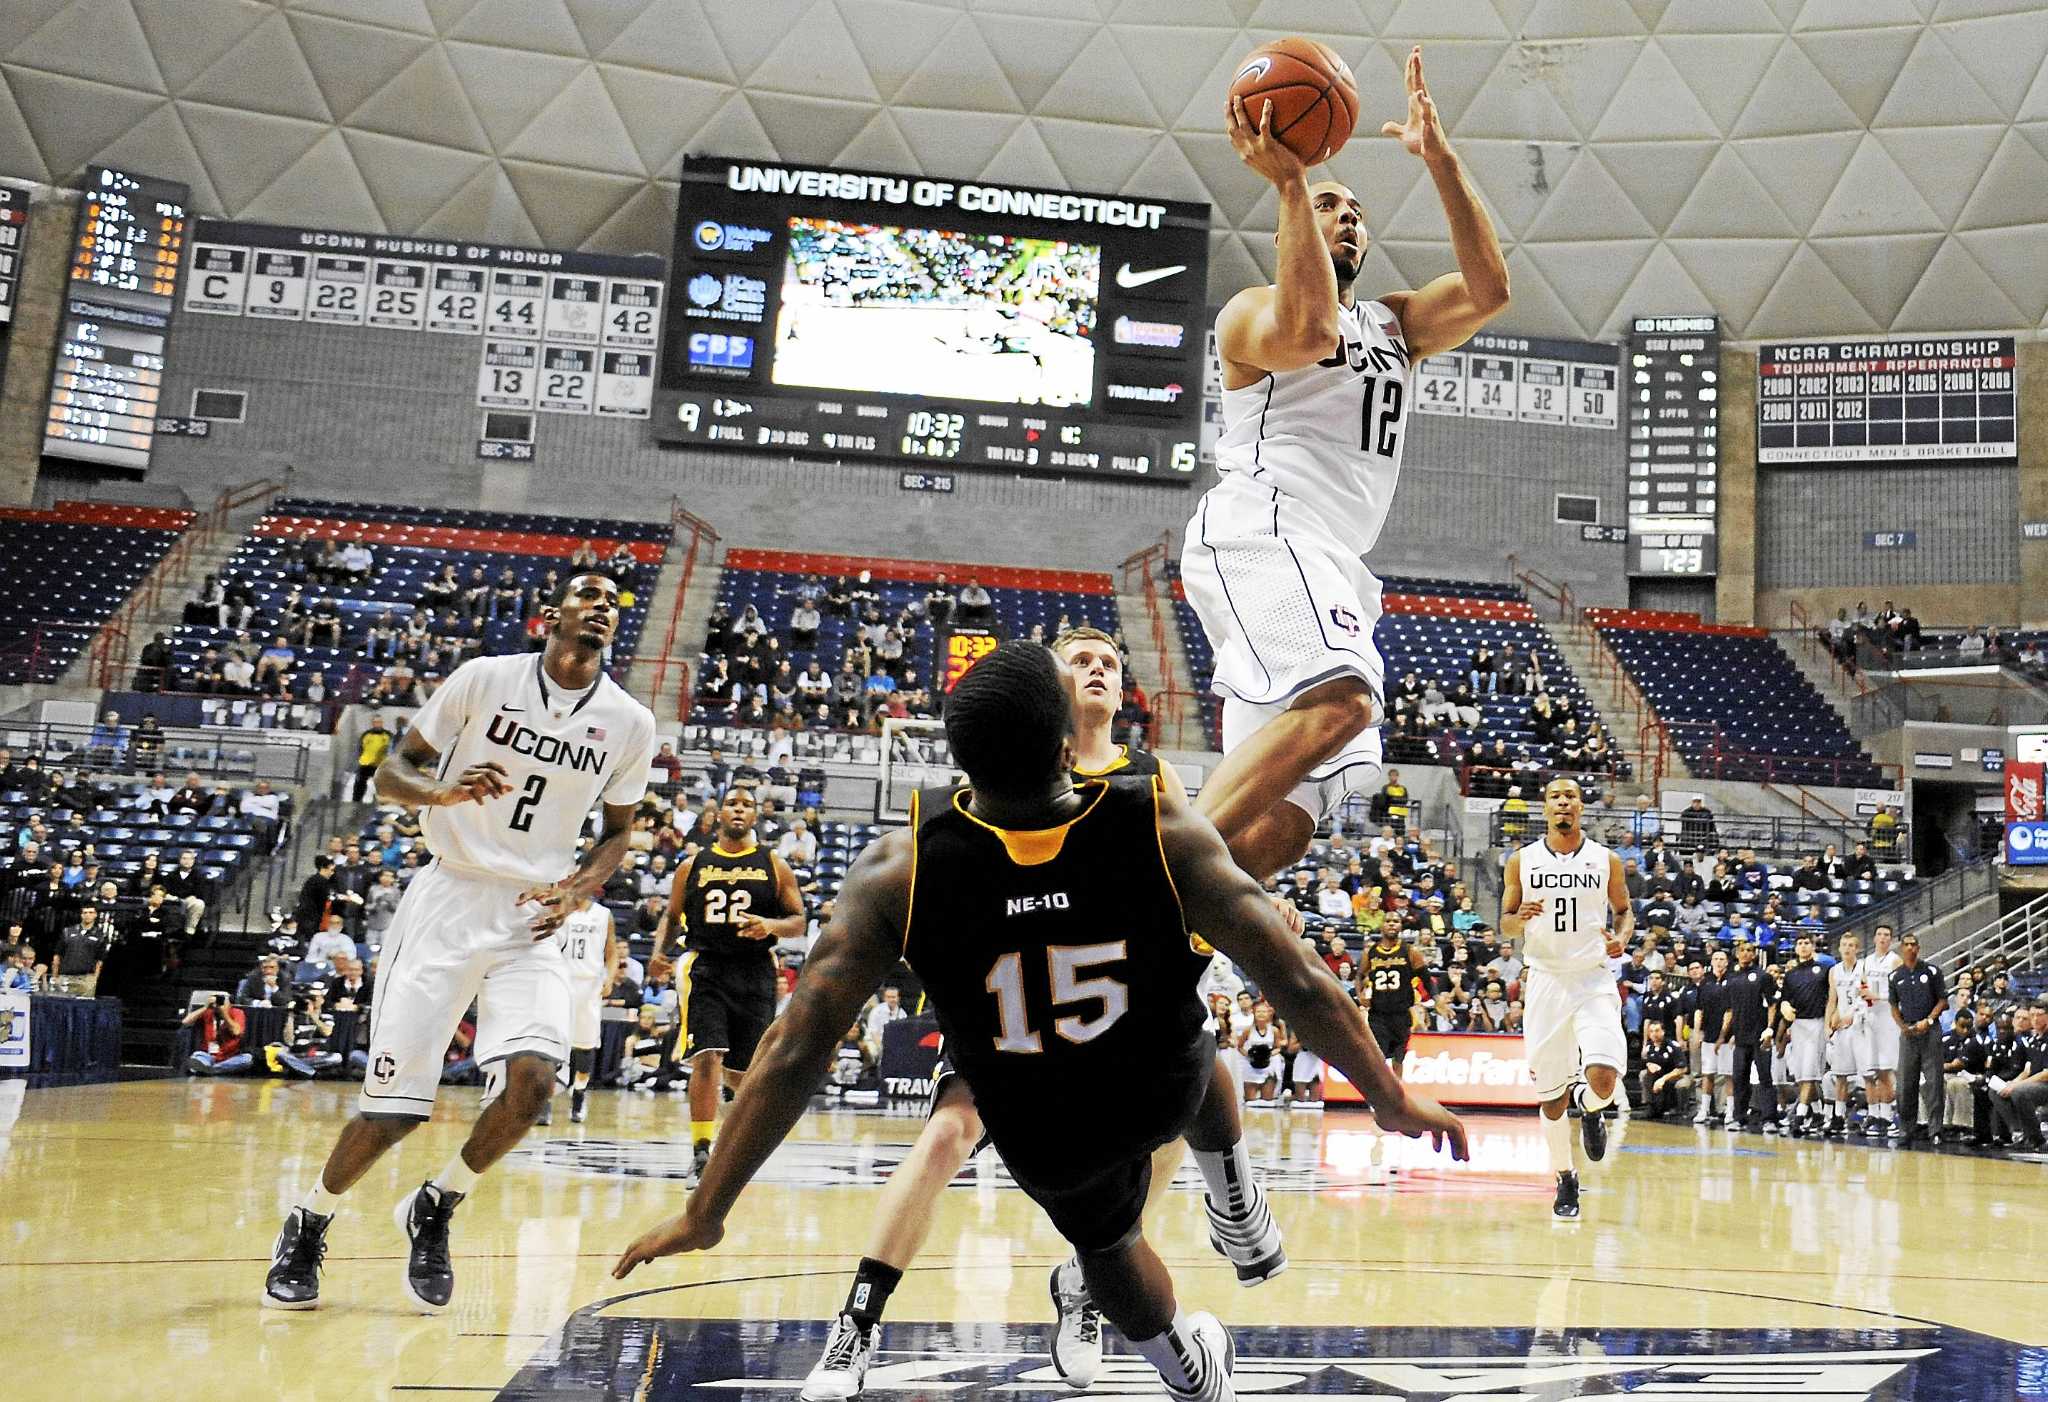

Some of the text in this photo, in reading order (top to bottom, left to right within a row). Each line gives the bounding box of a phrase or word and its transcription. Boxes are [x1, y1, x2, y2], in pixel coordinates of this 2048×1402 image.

[728, 166, 1167, 229] UNIVERSITY OF CONNECTICUT
[301, 232, 563, 266] UCONN HUSKIES OF HONOR
[203, 275, 229, 299] C
[269, 280, 285, 303] 9
[317, 285, 357, 310] 22
[376, 290, 418, 315] 25
[438, 295, 476, 320] 42
[496, 300, 535, 324] 44
[613, 310, 651, 334] 42
[1473, 336, 1529, 351] HONOR
[1775, 341, 2000, 360] NCAA CHAMPIONSHIP
[1773, 357, 2002, 374] TOURNAMENT APPEARANCES
[492, 369, 522, 393] 13
[548, 374, 584, 399] 22
[1424, 379, 1457, 402] 42
[1764, 378, 1792, 395] 2000
[1800, 377, 1827, 394] 2002
[1835, 375, 1864, 393] 2003
[1871, 374, 1900, 392] 2004
[1908, 374, 1936, 391] 2005
[1944, 373, 1973, 390] 2006
[1482, 384, 1501, 405] 34
[1534, 388, 1551, 410] 32
[1584, 392, 1604, 415] 50
[679, 403, 700, 432] 9
[1361, 376, 1402, 457] 12
[1800, 402, 1826, 419] 2011
[1836, 401, 1863, 418] 2012
[907, 411, 964, 439] 10:32
[1767, 449, 1861, 460] CONNECTICUT
[1917, 446, 2008, 457] BASKETBALL
[1875, 534, 1893, 546] SEC
[2024, 523, 2048, 537] WES
[1659, 549, 1701, 573] 7:23
[486, 714, 607, 775] UCONN
[508, 774, 547, 832] 2
[1530, 873, 1601, 889] UCONN
[705, 889, 752, 923] 22
[1007, 892, 1070, 916] NE-10
[1555, 897, 1577, 932] 21
[1375, 970, 1400, 990] 23
[985, 939, 1128, 1053] 15
[884, 1078, 935, 1095] TRAV
